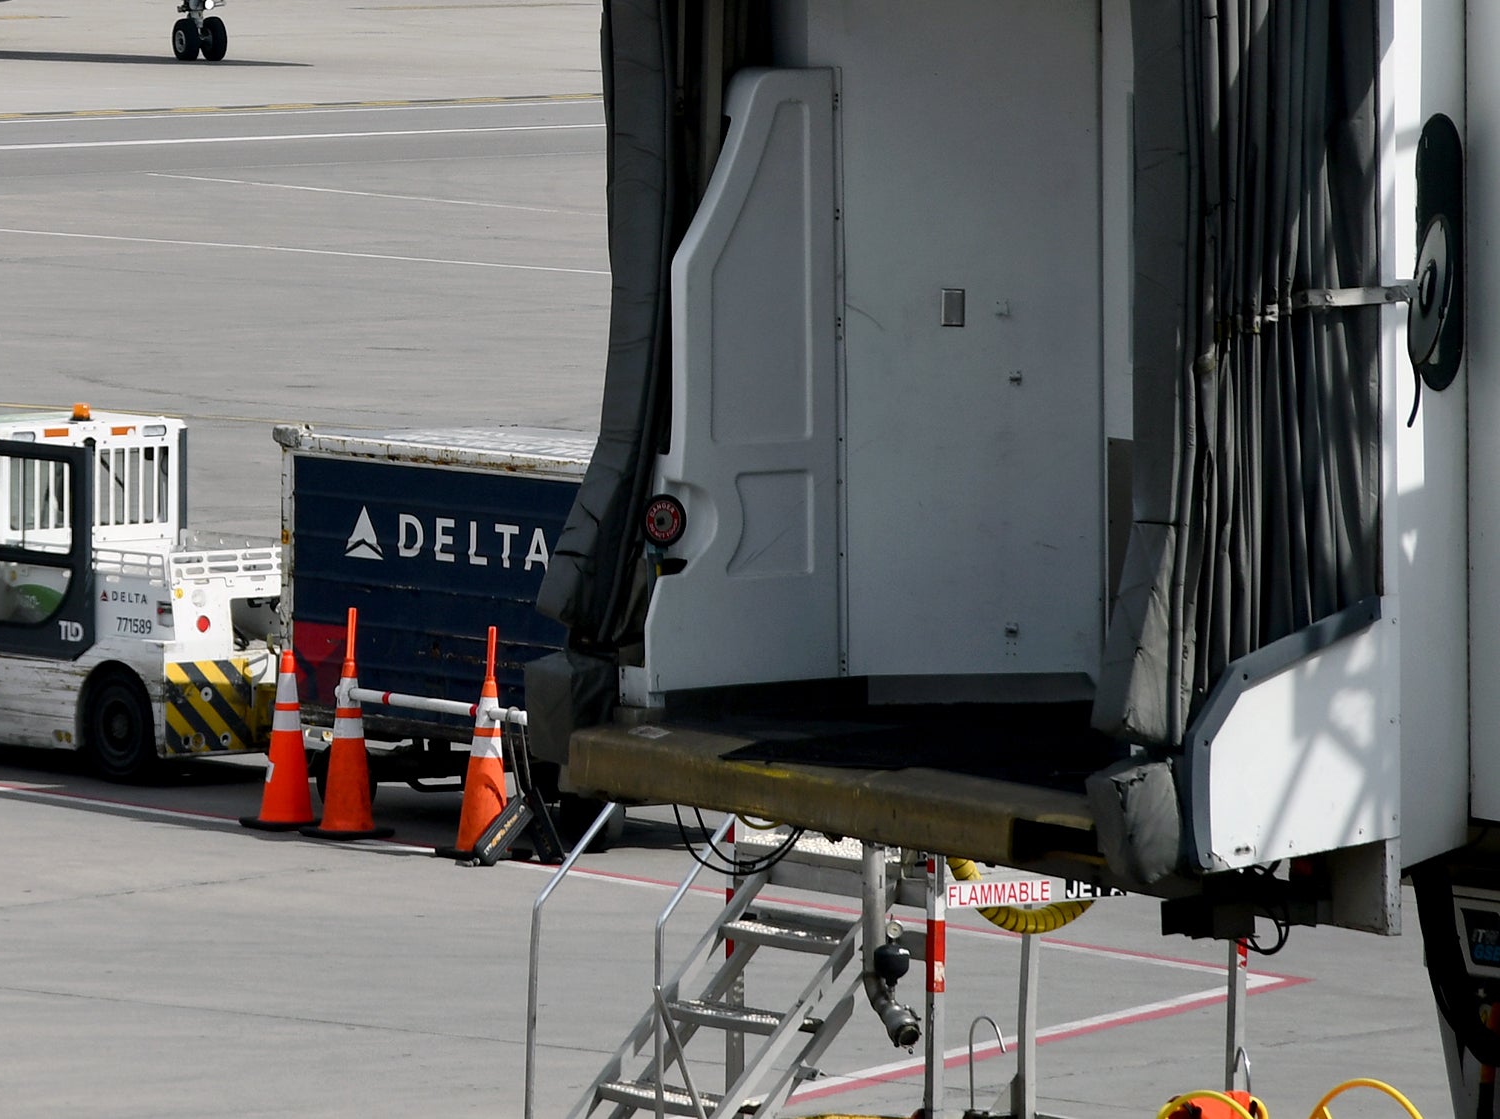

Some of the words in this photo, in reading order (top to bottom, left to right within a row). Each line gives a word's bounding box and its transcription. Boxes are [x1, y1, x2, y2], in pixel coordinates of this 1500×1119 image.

[397, 513, 549, 571] DELTA
[111, 590, 148, 605] DELTA
[58, 620, 84, 642] TLD
[116, 616, 152, 635] 771589
[948, 881, 1050, 907] FLAMMABLE
